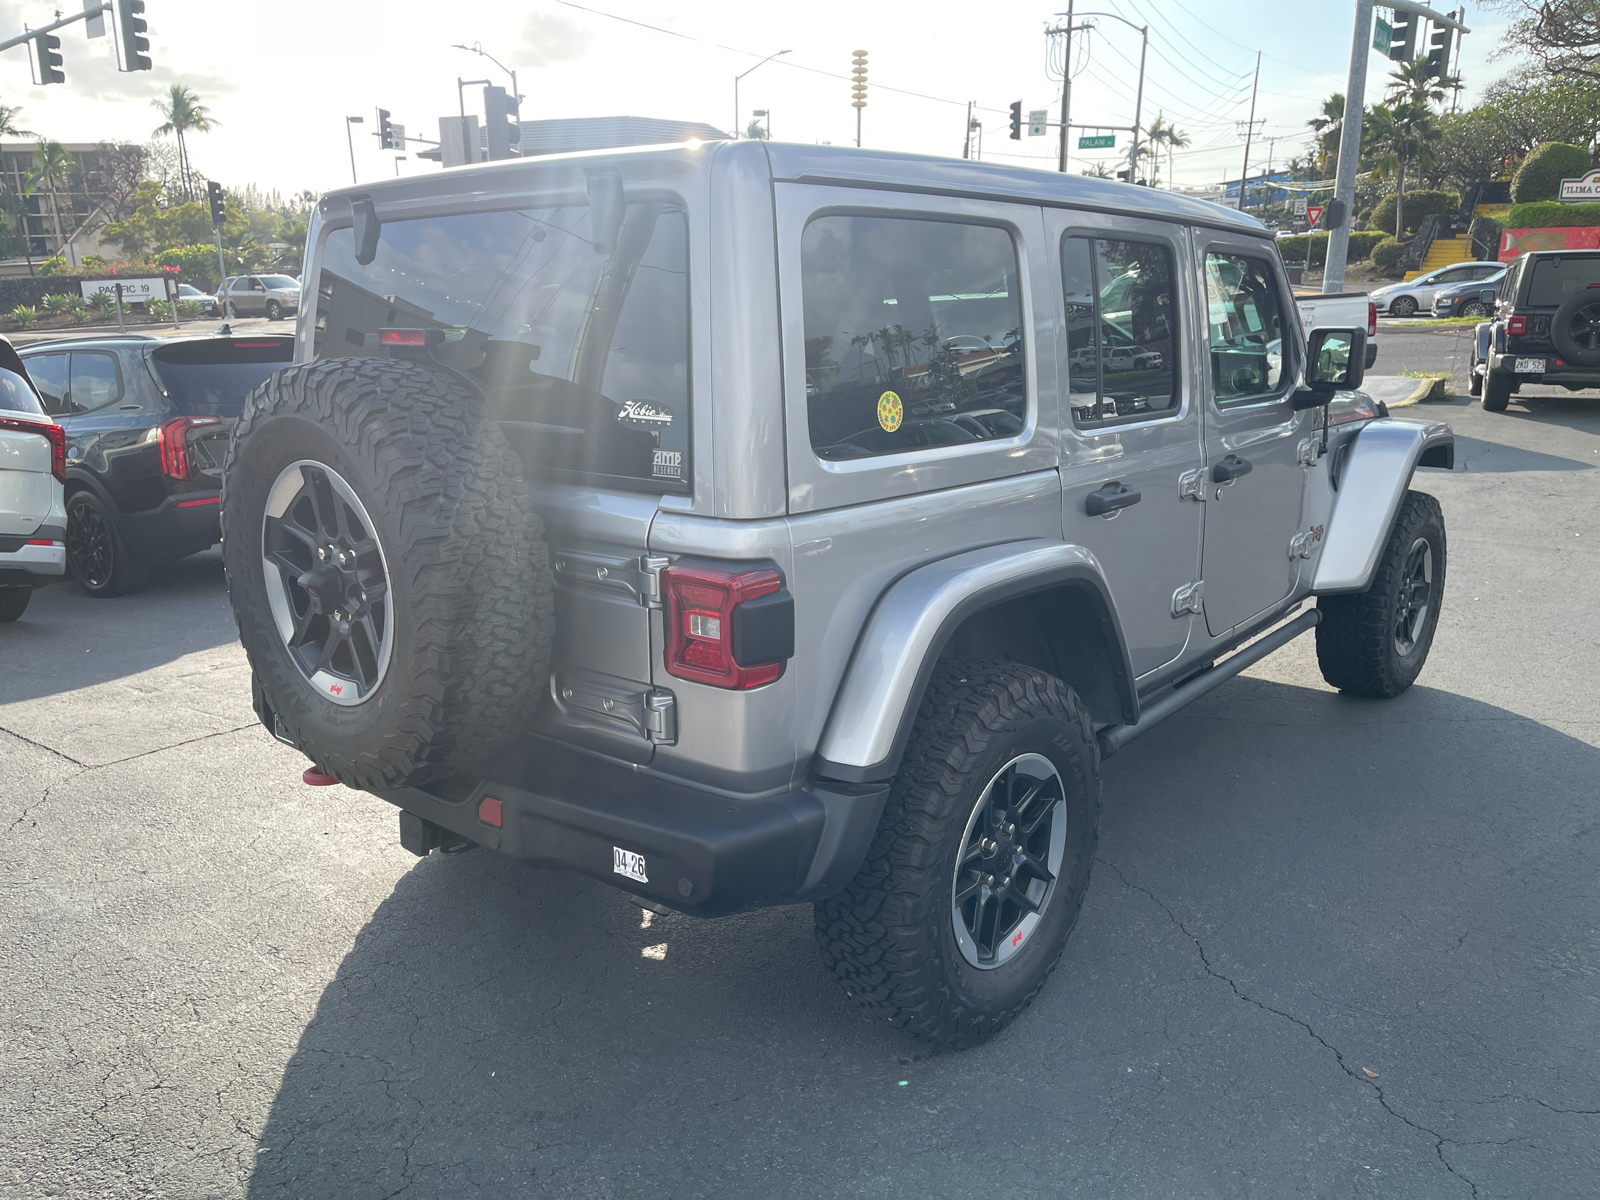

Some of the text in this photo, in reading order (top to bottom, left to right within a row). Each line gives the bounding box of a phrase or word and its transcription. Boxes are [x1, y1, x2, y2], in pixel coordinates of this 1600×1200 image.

[1081, 138, 1106, 147] PALANI
[1295, 206, 1306, 214] 25
[98, 285, 150, 294] PACFIC 19
[618, 401, 657, 418] Hobie
[618, 417, 671, 426] FISHING
[653, 451, 682, 466] AMP
[653, 465, 681, 476] RESEARCH
[614, 849, 628, 870] 04
[631, 854, 644, 876] 26
